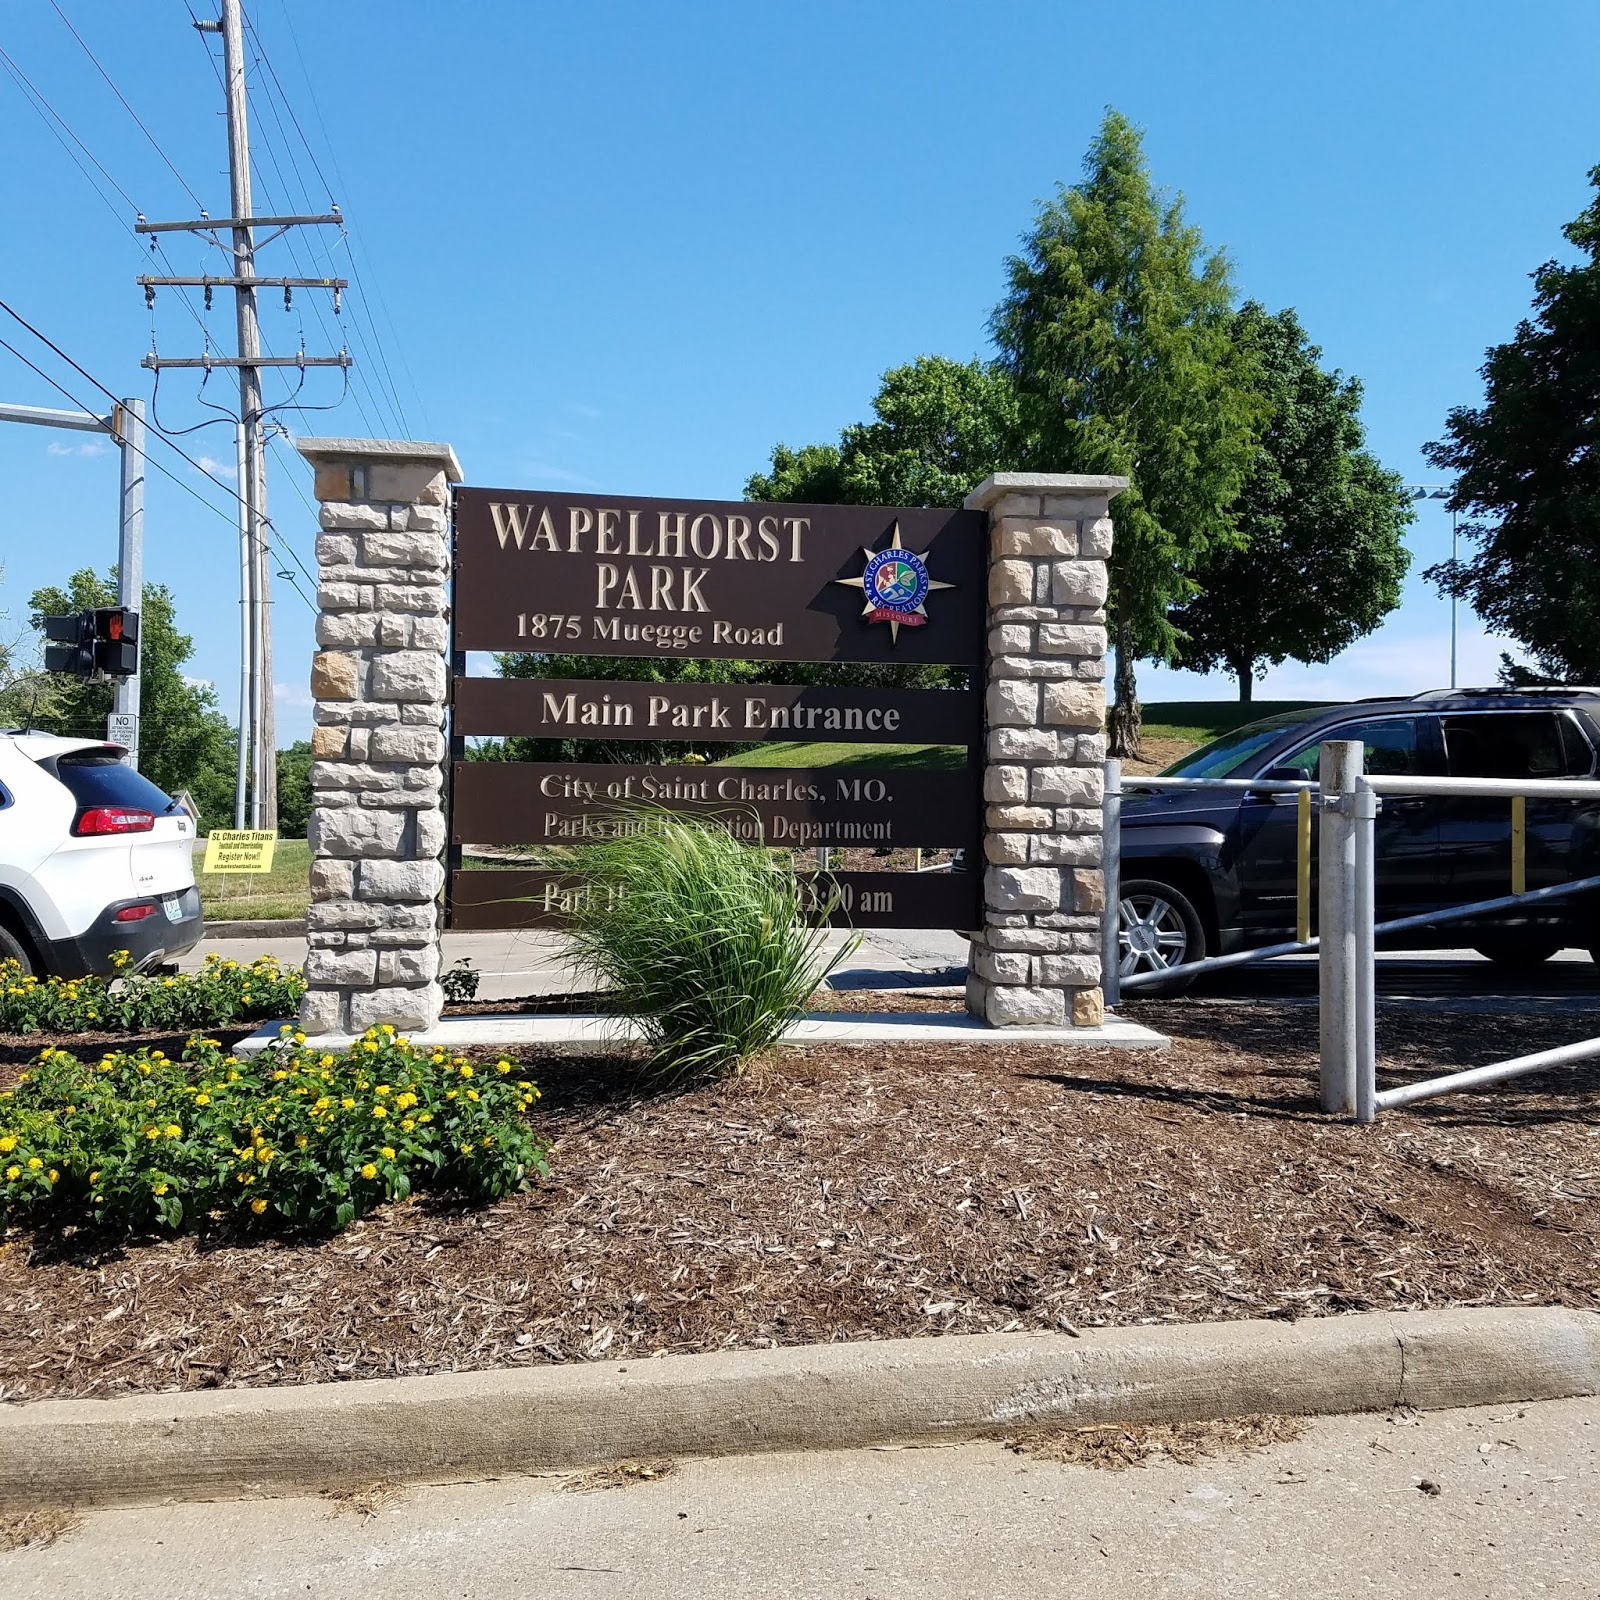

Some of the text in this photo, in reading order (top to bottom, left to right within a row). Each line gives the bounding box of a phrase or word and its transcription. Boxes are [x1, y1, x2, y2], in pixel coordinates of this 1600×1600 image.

[488, 502, 811, 562] WAPELHORST
[869, 551, 909, 570] CHARLES
[910, 557, 928, 584] PARKS
[595, 563, 711, 612] PARK
[871, 590, 926, 613] RECREATION
[517, 613, 784, 649] 1875 Muegge Road
[876, 611, 917, 623] MISSOURI
[115, 716, 129, 726] NO
[540, 692, 900, 731] Main Park Entrance
[540, 774, 894, 805] City of Saint Charles, MO.
[211, 832, 273, 841] St. Charles Titans
[544, 812, 605, 837] Parks
[612, 814, 648, 838] and
[772, 815, 892, 845] Department
[218, 851, 243, 862] Register
[860, 891, 893, 912] am
